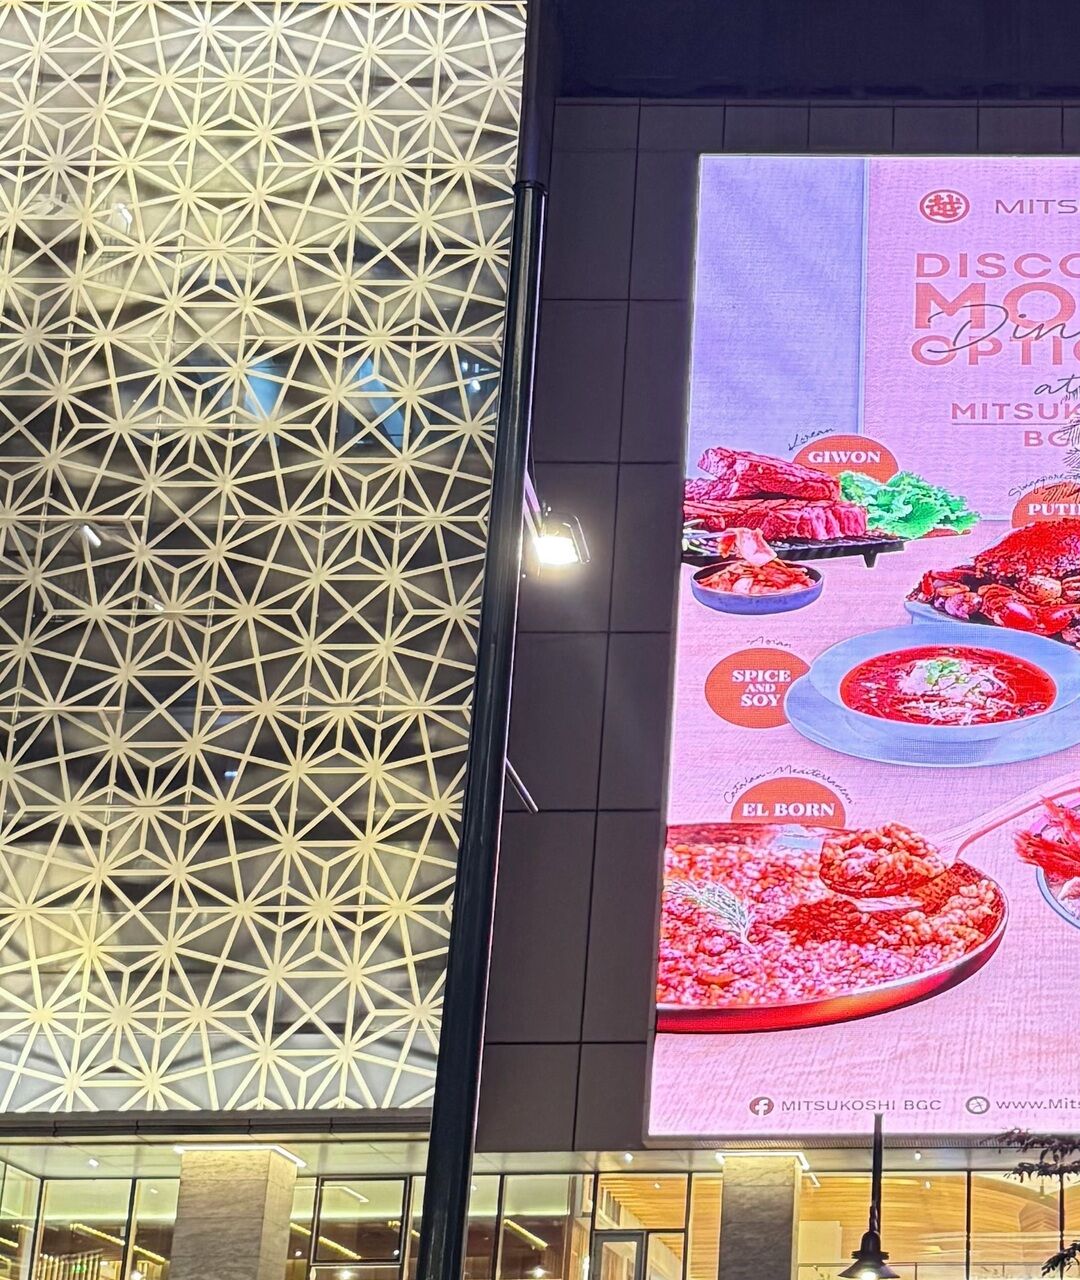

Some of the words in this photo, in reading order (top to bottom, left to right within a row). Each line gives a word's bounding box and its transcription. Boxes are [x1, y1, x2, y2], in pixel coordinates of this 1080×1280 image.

[1023, 430, 1077, 447] BG
[807, 450, 882, 464] GIWON
[731, 669, 792, 683] SPICE
[745, 683, 776, 693] AND
[740, 693, 781, 707] SOY
[742, 803, 770, 817] EL
[773, 803, 835, 817] BORN
[781, 1099, 896, 1111] MITSUKOSHI
[903, 1099, 942, 1111] BGC
